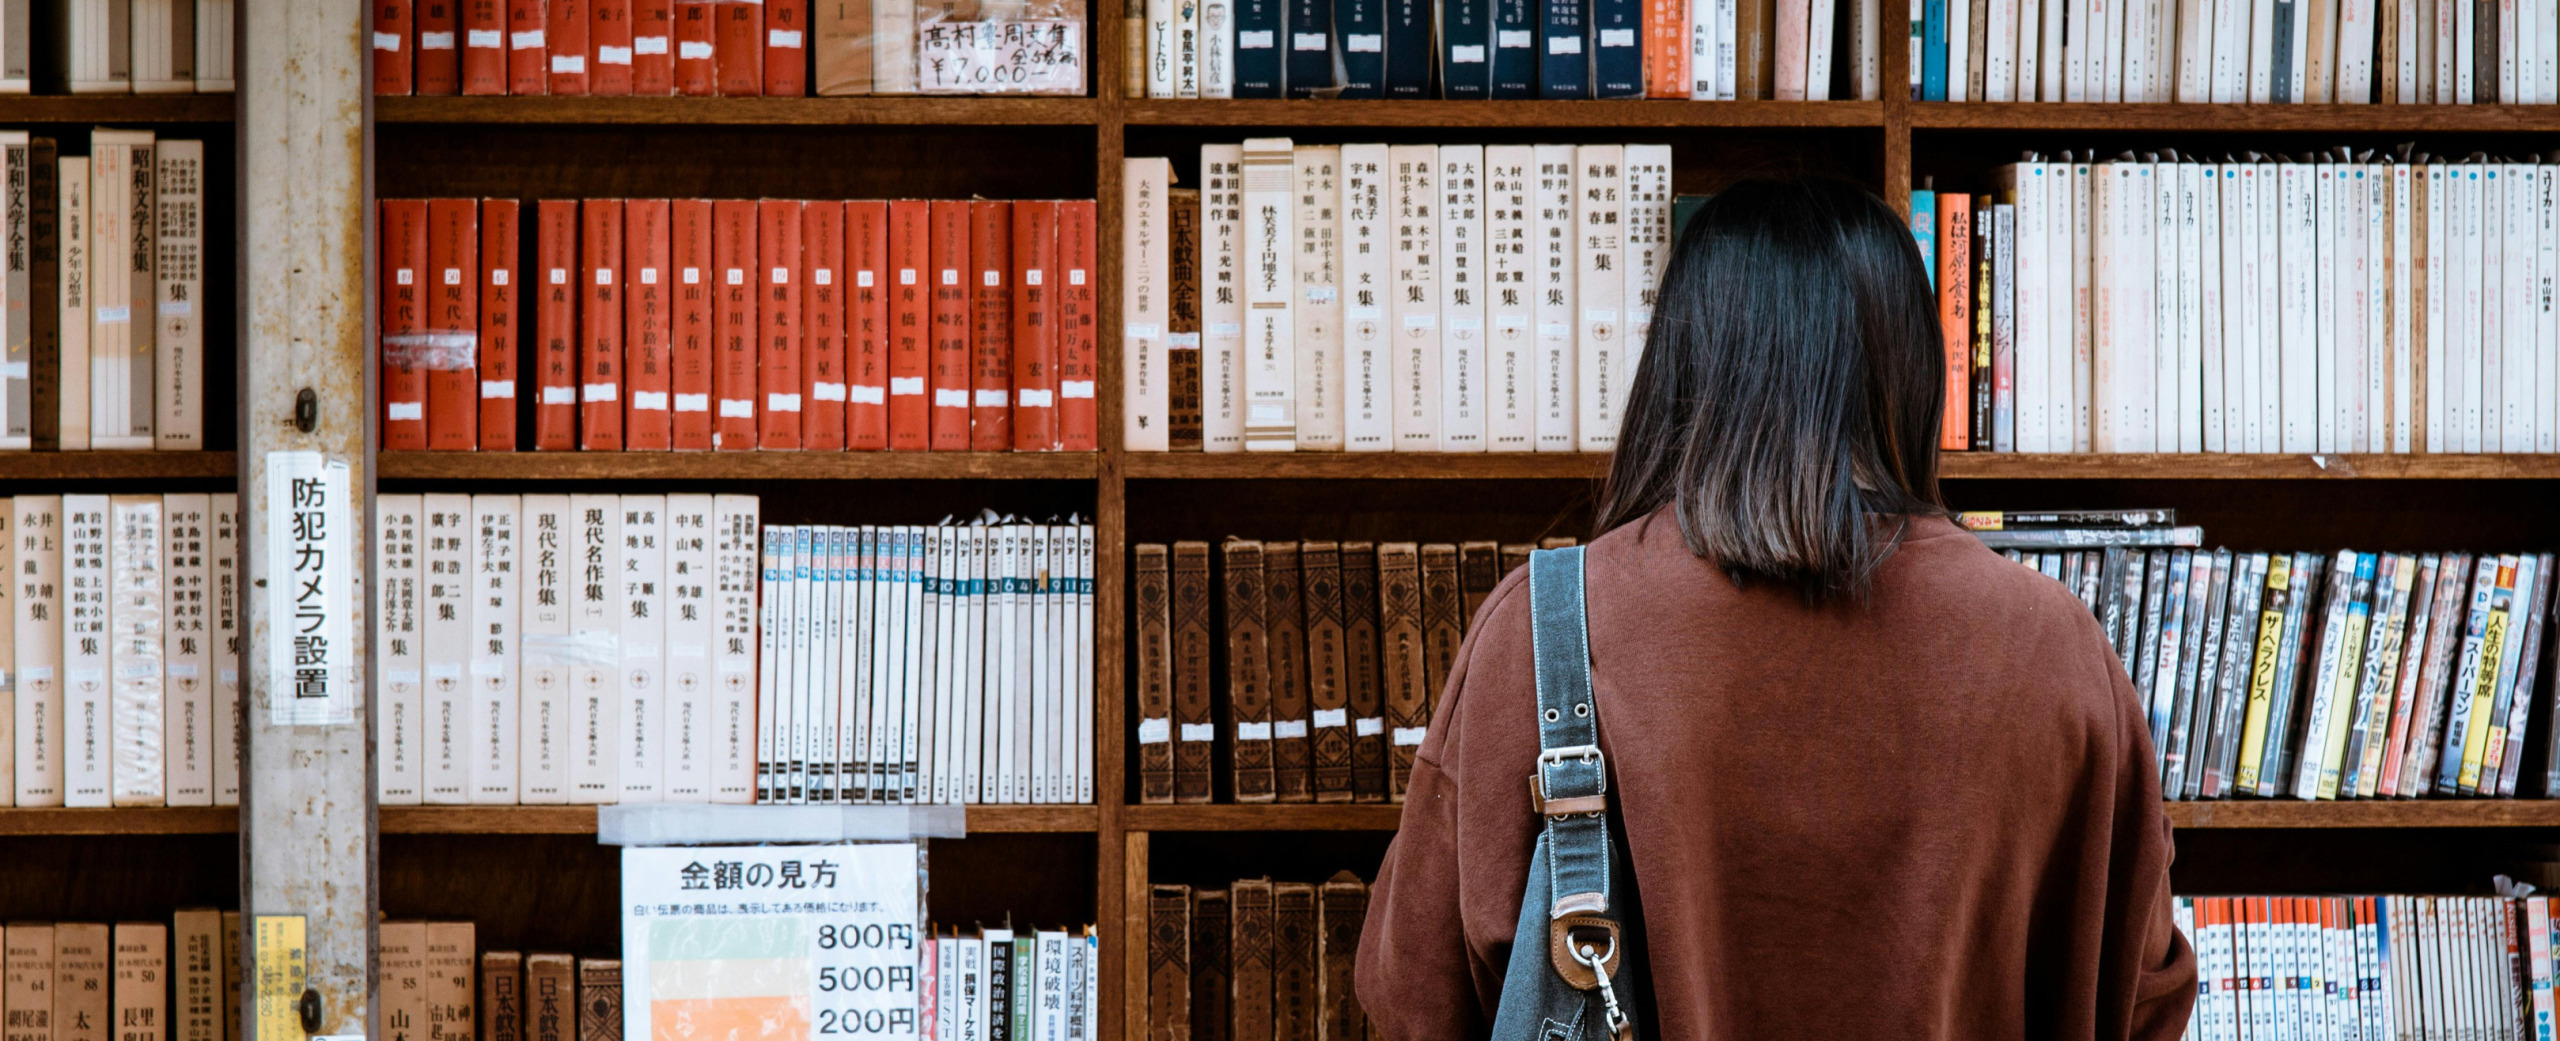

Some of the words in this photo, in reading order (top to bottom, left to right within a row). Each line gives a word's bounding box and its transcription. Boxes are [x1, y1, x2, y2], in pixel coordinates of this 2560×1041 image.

[1154, 20, 1168, 83] ビートたけし
[1181, 28, 1195, 91] 春風亭昇太
[1208, 33, 1222, 86] 小林信彦
[7, 147, 26, 273] 昭和文学全集
[132, 147, 150, 274] 昭和文学全集
[1210, 163, 1223, 221] 遠藤周作
[1303, 166, 1315, 221] 木下順二
[1351, 163, 1364, 220] 宇野千代
[1366, 163, 1379, 220] 林芙美子
[1358, 226, 1371, 284] 幸田文
[1417, 225, 1430, 281] 木下順二
[1495, 228, 1508, 283] 三好十郎
[1595, 254, 1612, 271] 集
[1216, 287, 1234, 304] 集
[1358, 290, 1375, 307] 集
[1407, 285, 1424, 303] 集
[1454, 288, 1471, 306] 集
[1502, 288, 1519, 306] 集
[1547, 289, 1563, 306] 集
[685, 287, 699, 374] 山本有三
[729, 288, 743, 375] 石川達三
[1027, 289, 1043, 377] 野間宏
[40, 513, 53, 599] 井上靖
[448, 513, 461, 599] 宇野浩二
[538, 514, 558, 606] 現代名作集
[585, 508, 604, 602] 現代名作集
[676, 514, 688, 599] 中山義秀
[691, 514, 704, 599] 尾崎一雄
[31, 602, 48, 622] 集
[292, 477, 329, 699] 防犯カメラ設置
[438, 603, 456, 621] 集
[80, 637, 98, 655] 集
[180, 637, 197, 655] 集
[391, 639, 408, 656] 集
[2253, 615, 2281, 701] ザ・ヘラクレス
[2477, 615, 2503, 698] 人生の特等席
[2456, 641, 2479, 716] スーパーマン
[680, 860, 840, 890] 金額の見方
[818, 924, 913, 950] 800円
[31, 980, 45, 992] 64
[84, 979, 98, 992] 88
[141, 971, 155, 983] 50
[402, 978, 417, 990] 55
[453, 977, 466, 989] 91
[819, 966, 914, 992] 500円
[1044, 938, 1063, 1010] 環境破壊
[1070, 946, 1084, 1039] スポーツ科学概論
[820, 1008, 914, 1034] 200円
